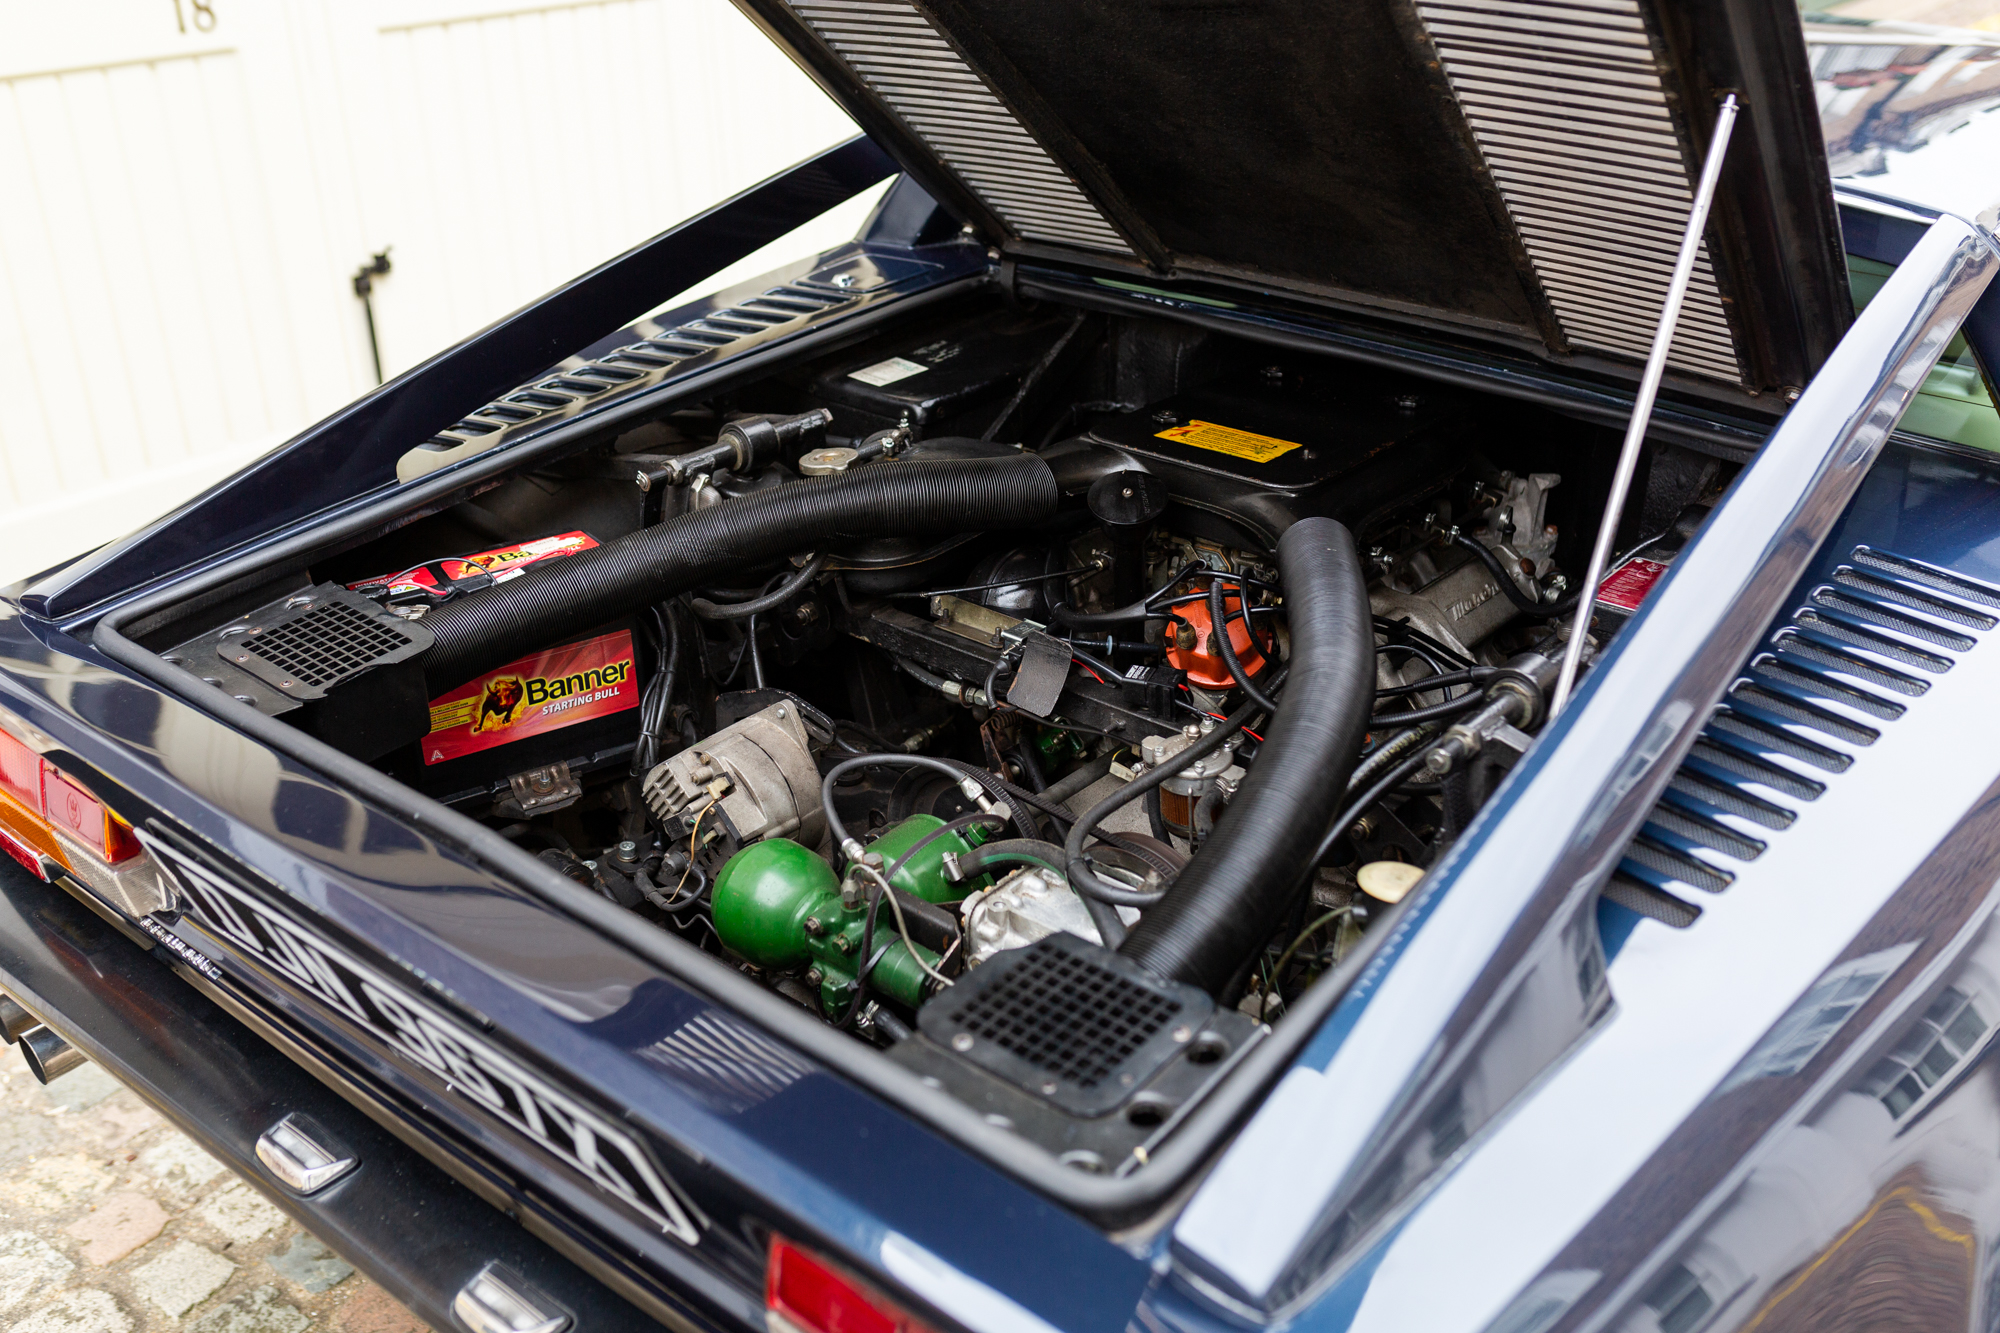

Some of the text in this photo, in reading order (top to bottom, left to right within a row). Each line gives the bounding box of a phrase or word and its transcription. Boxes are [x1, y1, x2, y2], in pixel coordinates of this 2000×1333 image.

[172, 0, 217, 34] 18
[525, 660, 630, 706] Banner
[542, 687, 621, 716] STARTING BULL
[176, 863, 638, 1198] DJN 967X
